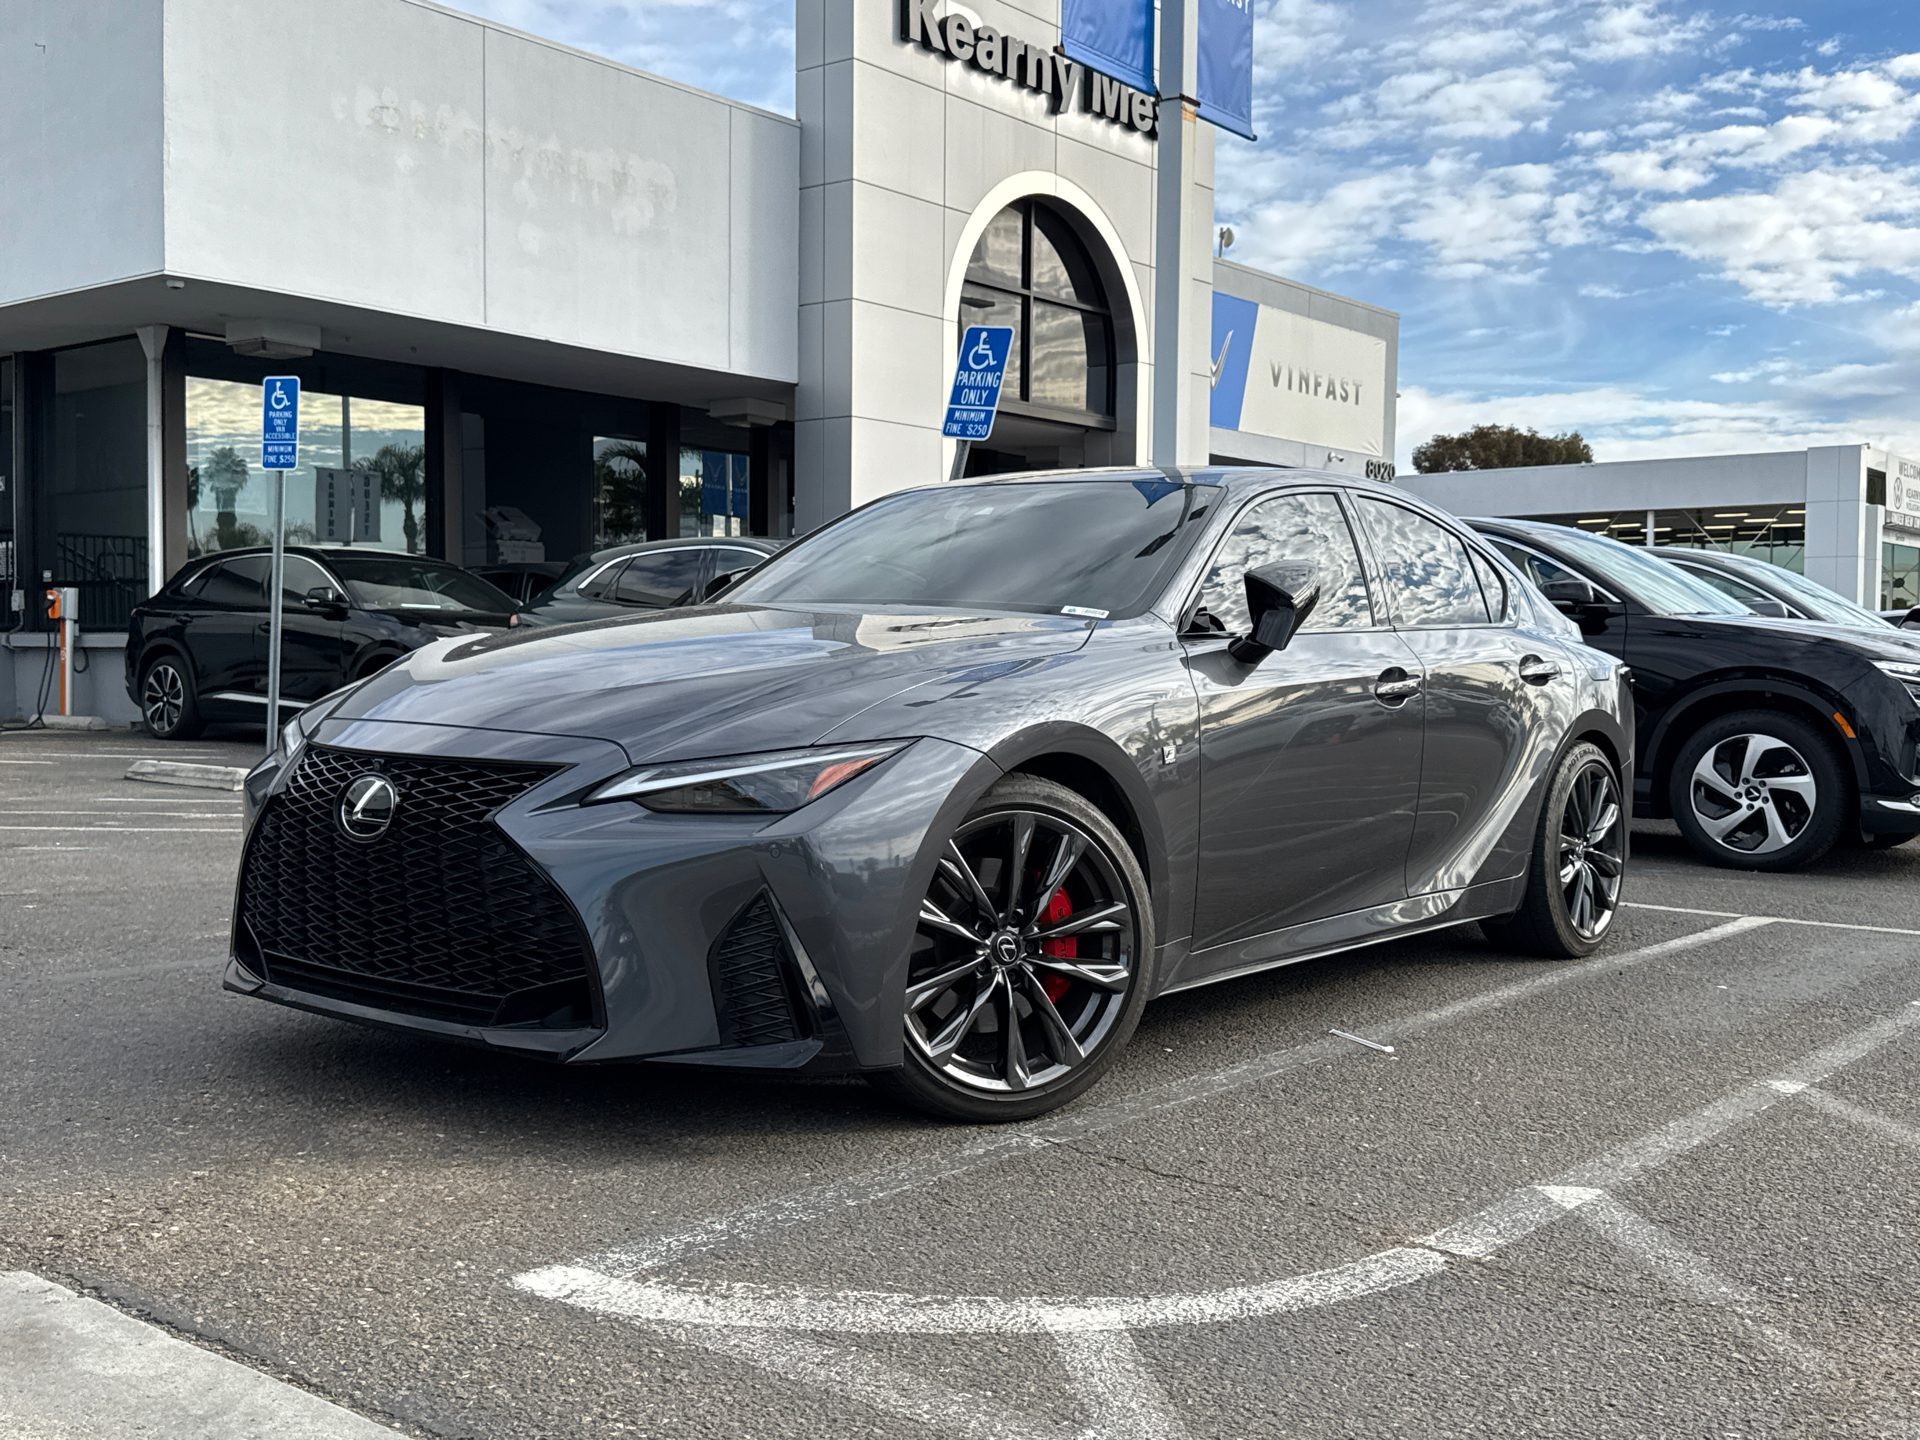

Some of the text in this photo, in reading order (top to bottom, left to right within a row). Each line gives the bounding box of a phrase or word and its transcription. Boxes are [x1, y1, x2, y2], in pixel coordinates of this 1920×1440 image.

[902, 0, 1158, 139] Kearny Me
[956, 371, 1001, 388] PARKING
[1270, 359, 1363, 406] VINFAST
[961, 388, 989, 405] ONLY
[273, 418, 288, 426] ONLY
[953, 410, 986, 422] MINIMUM
[265, 432, 296, 440] ACCESSIBLE
[945, 422, 988, 436] FINE $250
[267, 445, 293, 453] MINIMUM
[264, 455, 295, 464] FINE $250
[1365, 459, 1396, 482] 8020
[1567, 747, 1596, 774] POTENZA
